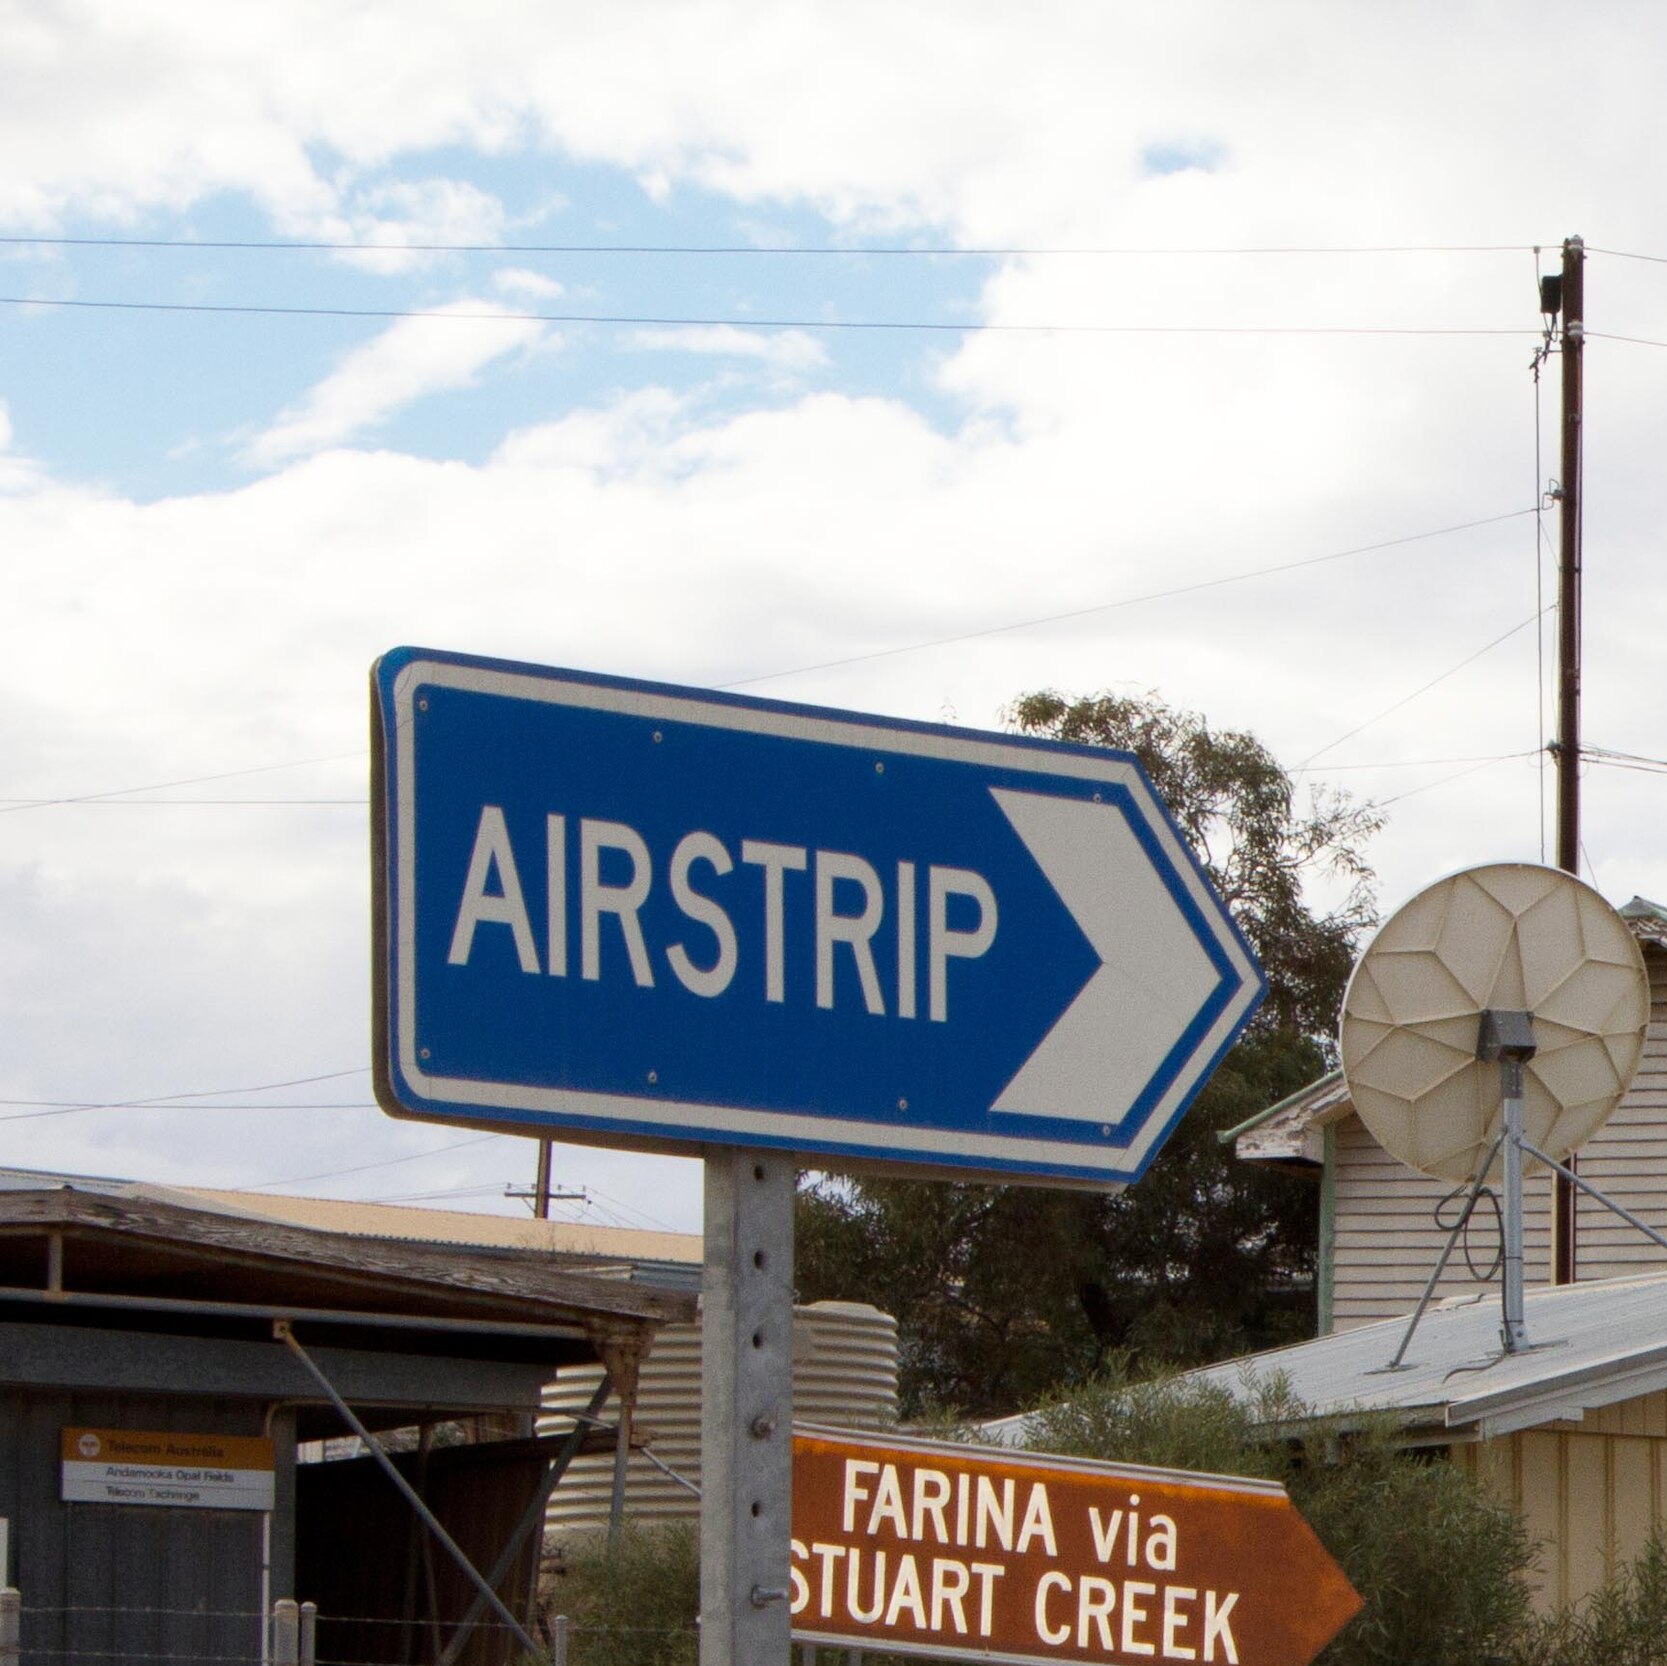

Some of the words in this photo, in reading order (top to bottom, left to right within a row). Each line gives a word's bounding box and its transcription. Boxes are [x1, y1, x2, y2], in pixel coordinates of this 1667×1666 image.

[447, 805, 999, 1023] AIRSTRIP
[106, 1465, 173, 1480] Andamooka
[175, 1469, 201, 1482] Opal
[204, 1471, 234, 1483] Fields
[108, 1439, 161, 1454] Telecom
[166, 1442, 225, 1458] Australia
[842, 1458, 1058, 1557] FARINA
[1089, 1493, 1177, 1571] via
[791, 1538, 1005, 1637] STUART
[1034, 1571, 1240, 1665] CREEK
